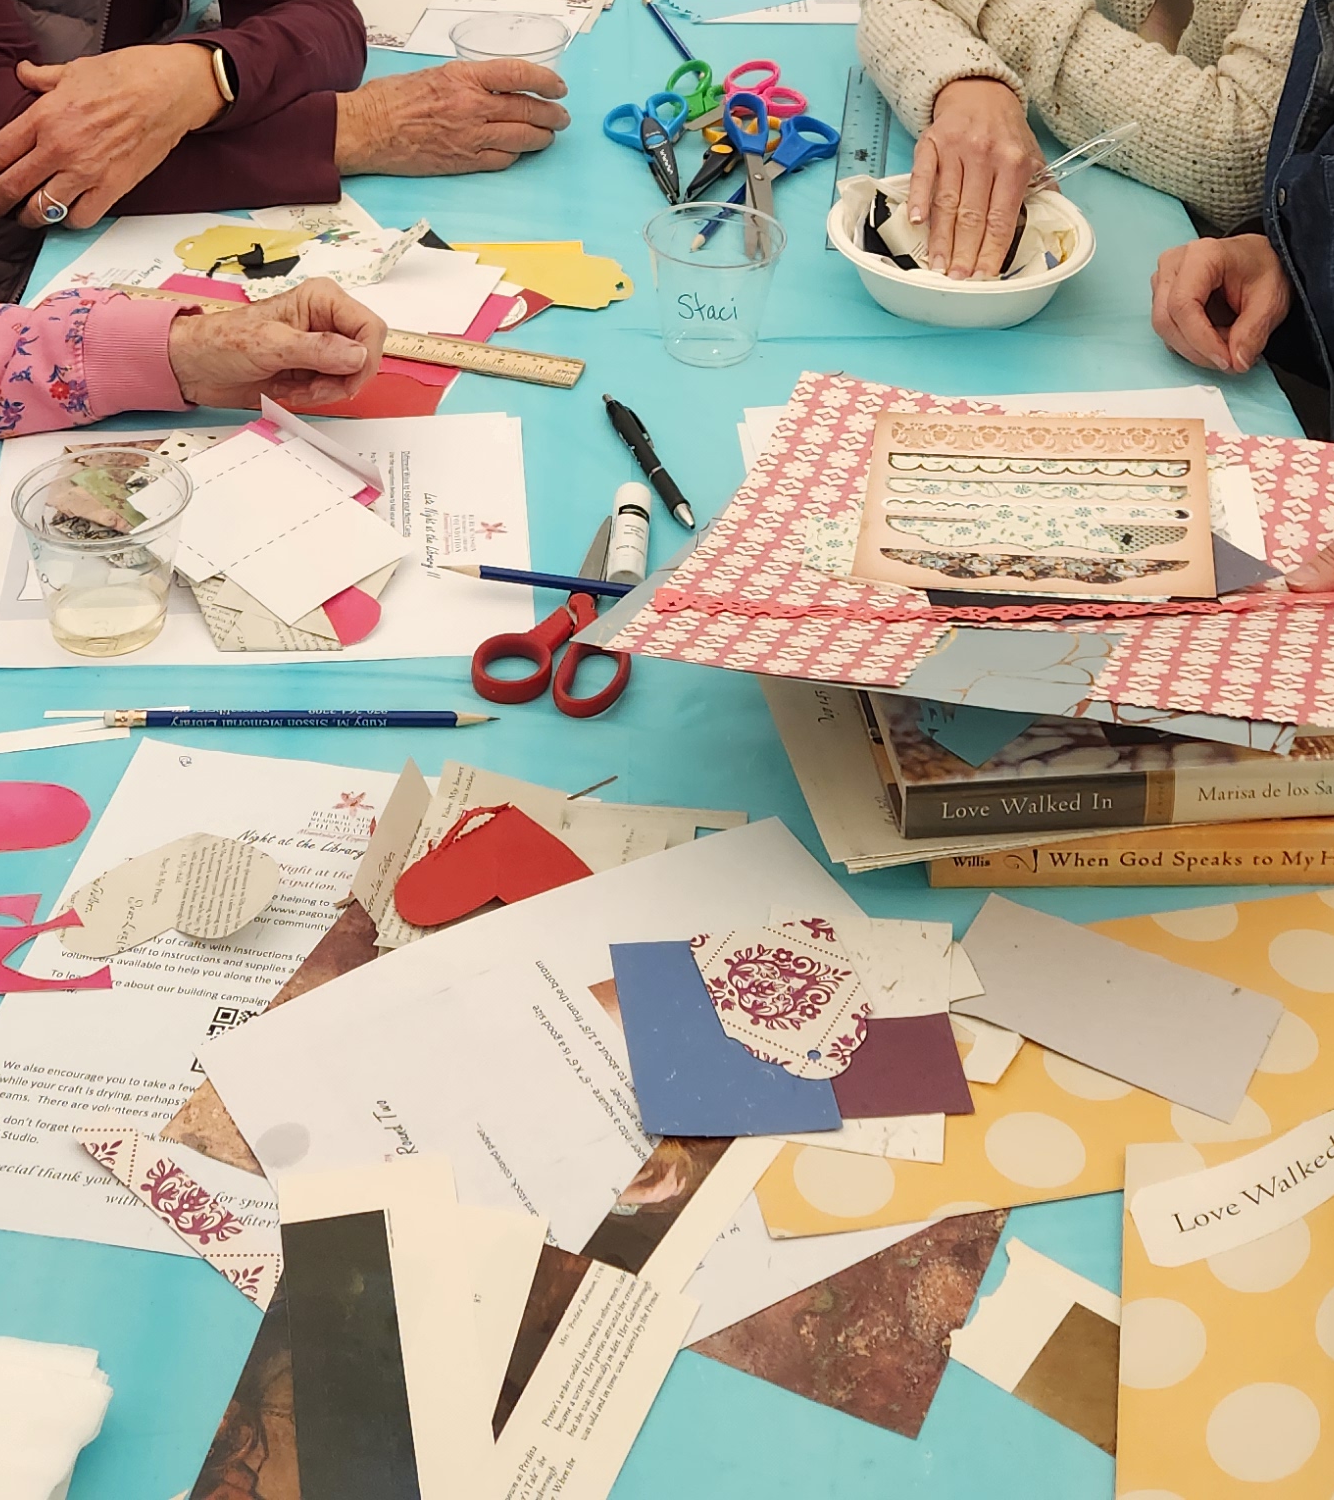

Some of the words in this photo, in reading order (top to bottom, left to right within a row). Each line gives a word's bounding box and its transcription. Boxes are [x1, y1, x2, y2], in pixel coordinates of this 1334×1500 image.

[678, 293, 738, 322] Staci
[1197, 784, 1257, 803] Marisa
[1262, 782, 1282, 798] de
[1286, 781, 1310, 797] los
[941, 801, 991, 820] Love
[1000, 793, 1082, 816] Walked
[1092, 793, 1113, 810] In
[278, 838, 293, 846] at
[295, 837, 316, 850] the
[320, 842, 365, 860] Library
[952, 855, 991, 868] Willis
[1048, 851, 1110, 868] When
[1119, 851, 1163, 867] God
[1172, 851, 1243, 871] Speaks
[1251, 853, 1274, 867] to
[1280, 851, 1315, 870] My
[314, 869, 330, 877] at
[334, 868, 353, 880] the
[280, 894, 317, 908] helping
[319, 899, 330, 907] to
[273, 918, 332, 932] community
[149, 948, 159, 956] to
[161, 948, 221, 964] instructions
[223, 957, 241, 968] and
[243, 960, 286, 974] supplies
[165, 937, 179, 946] of
[185, 939, 206, 950] crafts
[209, 942, 231, 953] with
[233, 946, 291, 961] instructions
[117, 957, 162, 972] available
[165, 964, 175, 973] to
[177, 964, 199, 978] help
[202, 968, 222, 979] you
[224, 969, 251, 983] along
[255, 974, 272, 986] the
[533, 958, 559, 990] bottom
[50, 969, 64, 978] To
[124, 980, 155, 991] about
[157, 983, 176, 993] our
[178, 983, 219, 1000] building
[552, 986, 570, 1005] the
[529, 1002, 547, 1022] size
[562, 1000, 584, 1024] from
[541, 1017, 563, 1043] good
[597, 1044, 620, 1072] about
[2, 1060, 21, 1071] We
[23, 1062, 45, 1074] also
[48, 1068, 104, 1083] encourage
[105, 1074, 127, 1086] you
[129, 1077, 140, 1086] to
[143, 1079, 166, 1090] take
[30, 1080, 55, 1092] your
[58, 1081, 84, 1094] craft
[86, 1085, 94, 1096] is
[96, 1087, 133, 1102] drying,
[37, 1095, 68, 1108] There
[70, 1100, 89, 1110] are
[589, 1084, 619, 1120] square
[367, 1095, 397, 1127] Two
[606, 1084, 638, 1123] another
[1, 1129, 39, 1144] Studio.
[35, 1119, 69, 1133] forget
[383, 1121, 420, 1162] Round
[37, 1165, 81, 1183] thank
[84, 1173, 113, 1187] you
[488, 1148, 514, 1180] colored
[1171, 1202, 1241, 1234] Love
